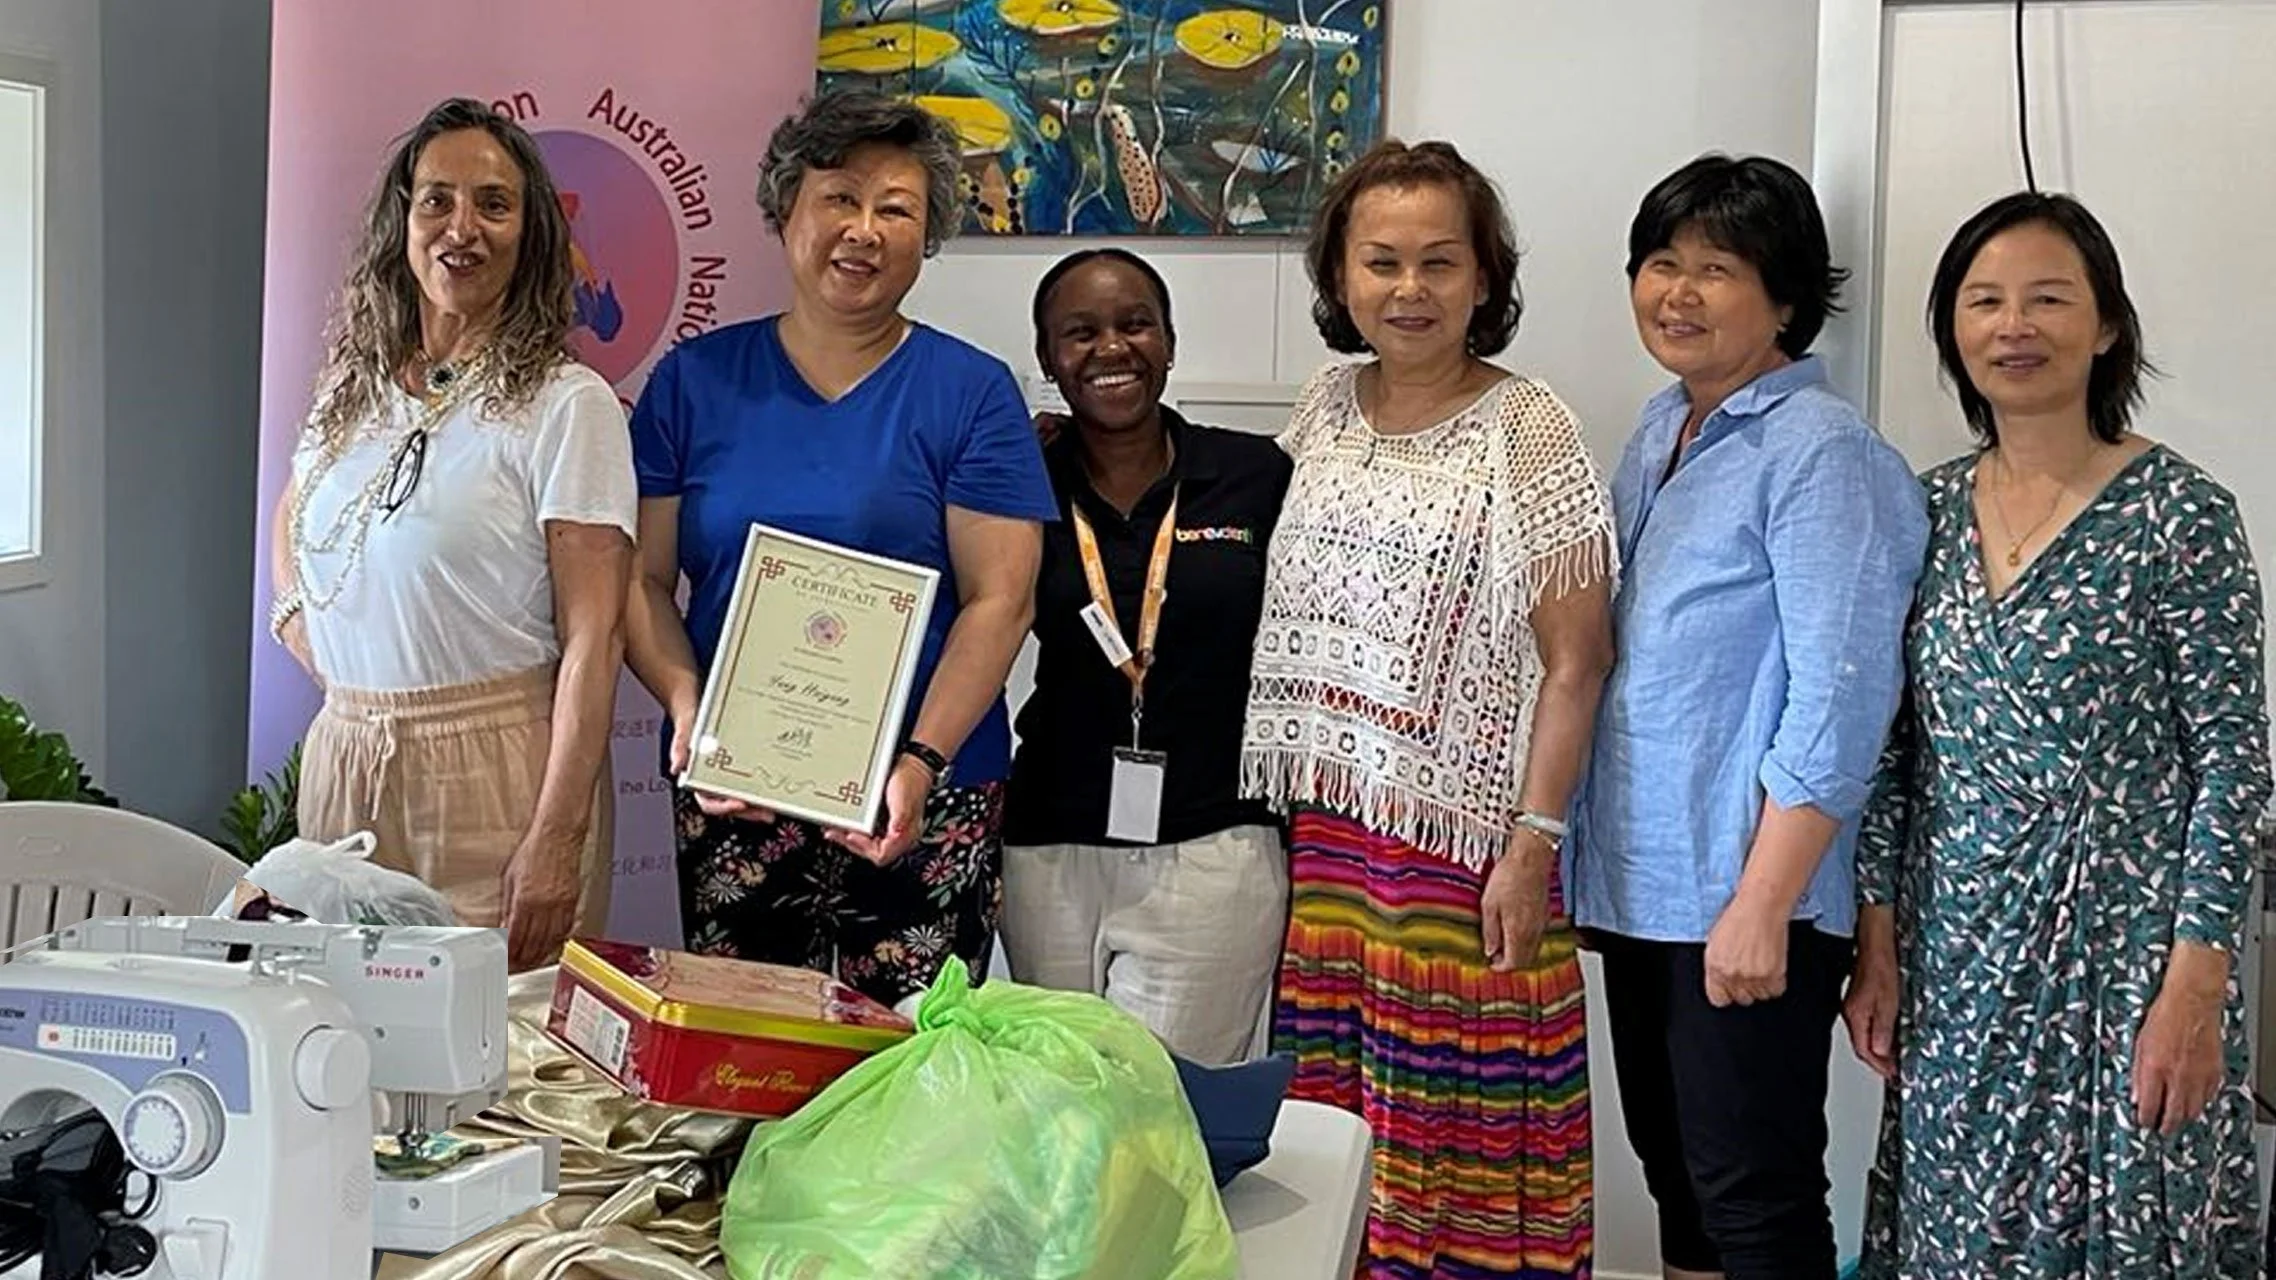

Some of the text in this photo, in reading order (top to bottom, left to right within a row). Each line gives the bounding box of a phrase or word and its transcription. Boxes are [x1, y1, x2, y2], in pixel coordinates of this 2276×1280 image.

[588, 87, 712, 230] Australian
[672, 256, 726, 345] Natio
[791, 574, 877, 607] CERTIFICATE
[365, 965, 424, 979] SINGER
